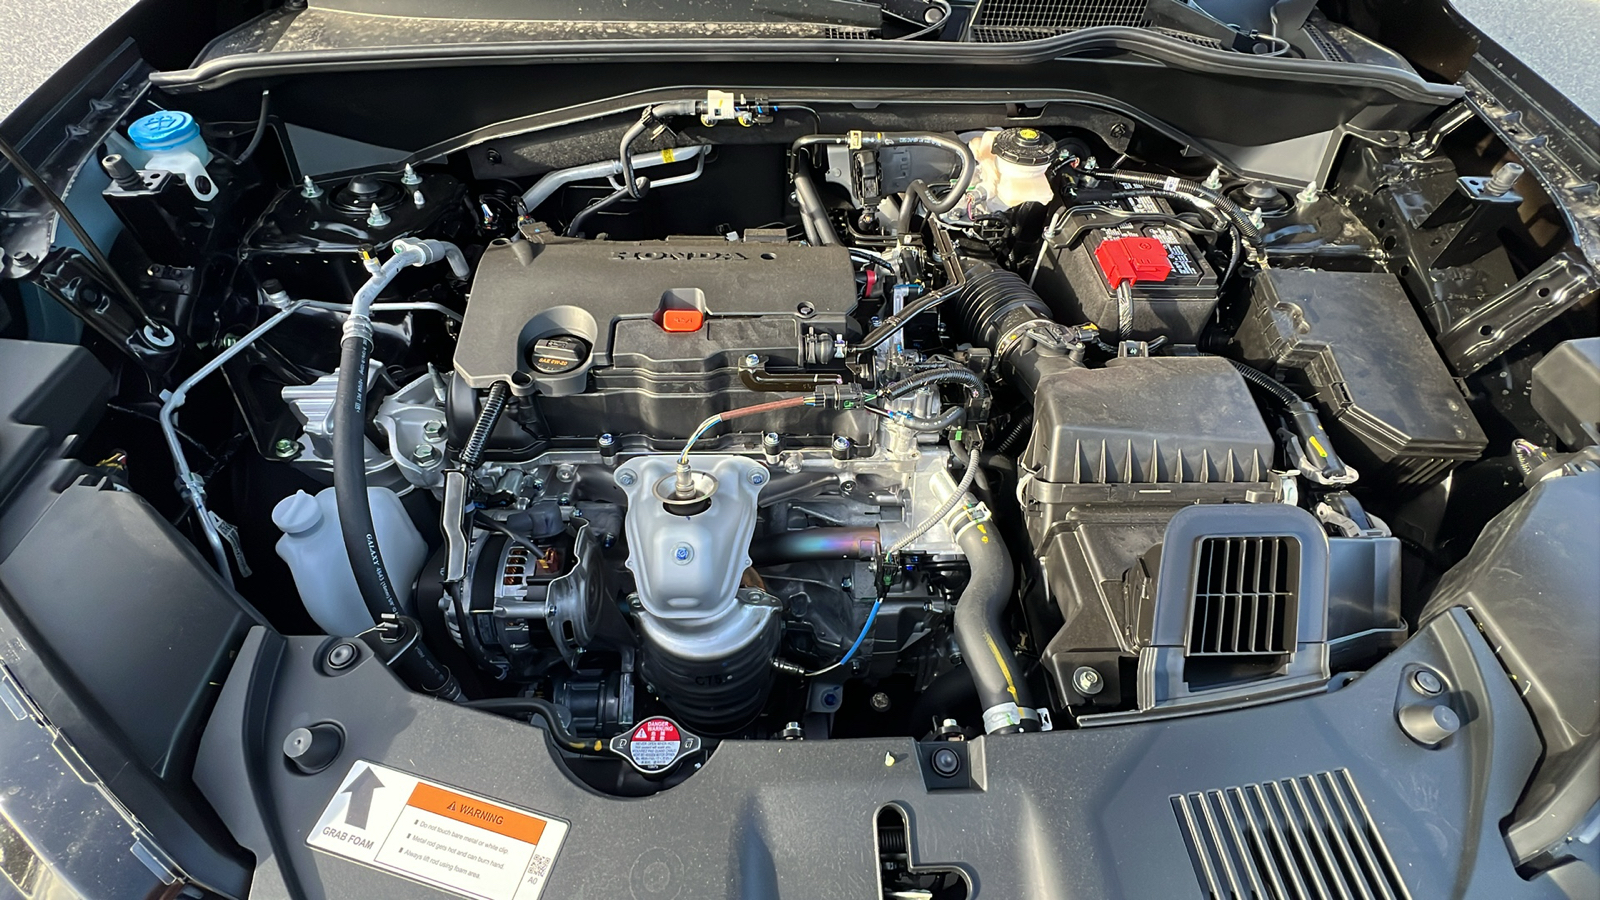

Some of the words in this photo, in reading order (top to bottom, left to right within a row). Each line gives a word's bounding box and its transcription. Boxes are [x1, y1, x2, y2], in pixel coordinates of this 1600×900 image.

[609, 251, 749, 260] HONDA
[366, 533, 380, 566] GALAXY
[460, 804, 504, 825] WARNING
[322, 826, 348, 841] GRAB
[347, 834, 375, 850] FOAM
[412, 834, 427, 844] Metal
[427, 840, 437, 848] rod
[435, 843, 447, 852] gets
[447, 846, 457, 854] hot
[456, 850, 468, 858] and
[467, 853, 477, 861] can
[477, 856, 490, 865] burn
[437, 826, 451, 835] touch
[451, 831, 463, 840] bare
[463, 835, 478, 845] metal
[484, 843, 498, 851] white
[403, 849, 422, 860] Always
[422, 854, 430, 863] lift
[429, 858, 440, 866] rod
[439, 861, 454, 872] using
[453, 865, 468, 875] foam
[527, 876, 538, 885] A0
